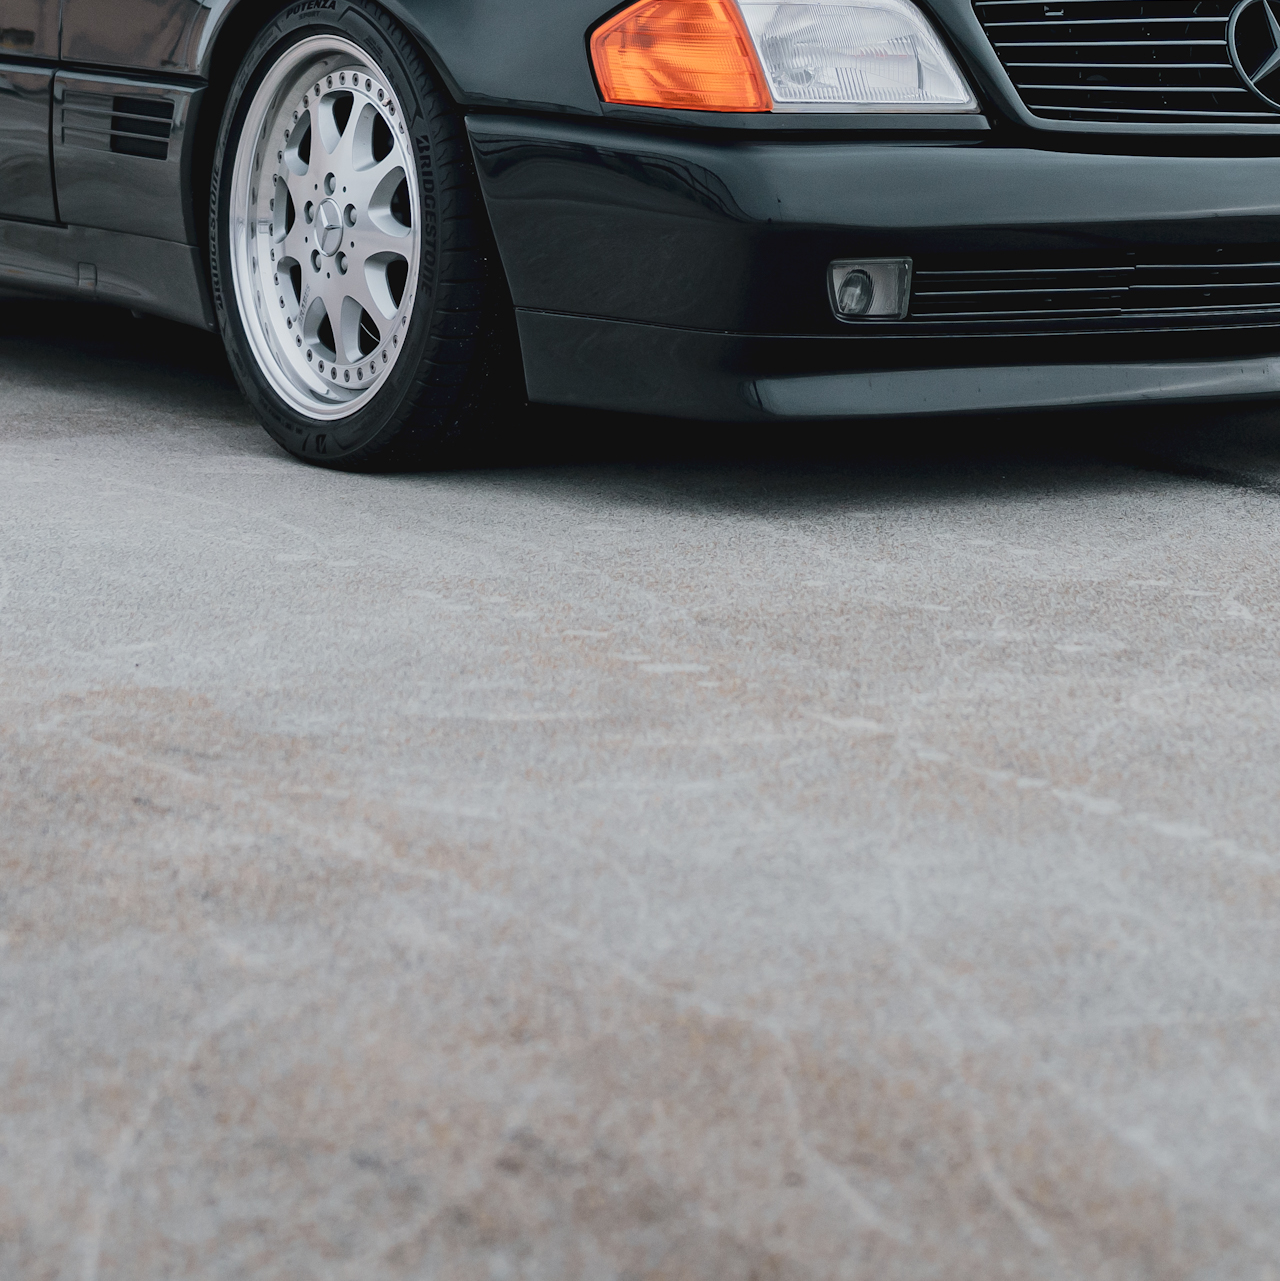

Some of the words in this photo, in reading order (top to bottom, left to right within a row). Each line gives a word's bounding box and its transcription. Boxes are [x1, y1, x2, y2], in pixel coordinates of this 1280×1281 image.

[286, 0, 336, 19] POTENZA
[210, 168, 224, 310] BRIDGESTONE
[416, 135, 436, 297] BRIDGESTONE
